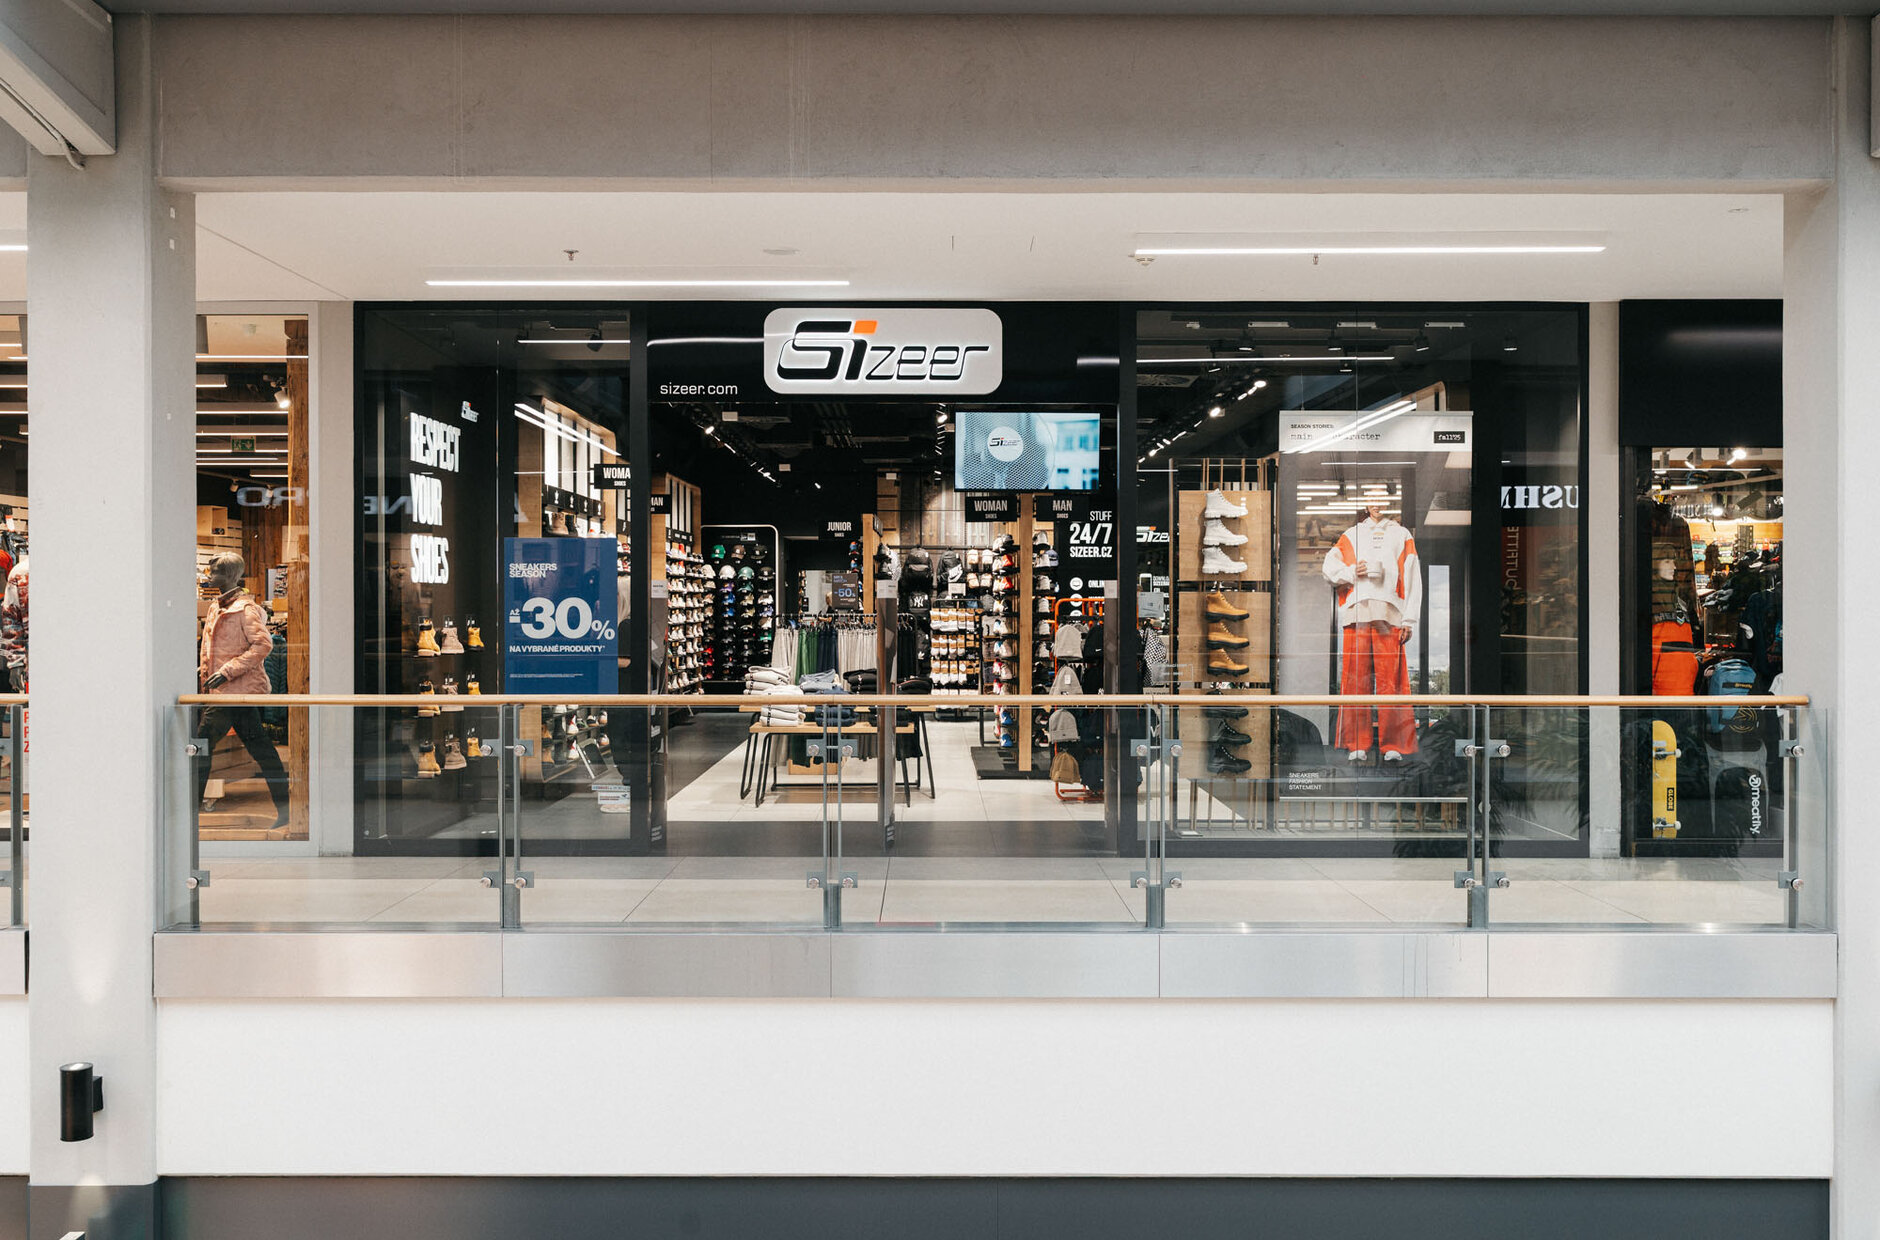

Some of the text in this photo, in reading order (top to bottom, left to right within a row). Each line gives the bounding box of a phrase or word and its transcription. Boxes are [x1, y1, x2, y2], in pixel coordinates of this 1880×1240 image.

[777, 320, 989, 380] Sizeer
[660, 382, 738, 394] sizeer.com
[410, 412, 461, 472] RESPECT
[603, 467, 631, 479] WOMA
[409, 473, 443, 526] YOUR
[974, 500, 1008, 511] WOMAN
[1053, 500, 1073, 511] MAN
[1090, 511, 1112, 521] STUFF
[827, 521, 852, 531] JUNIOR
[1069, 523, 1112, 544] 24/7
[1069, 546, 1112, 558] SIZEER.CZ
[410, 533, 449, 584] SHOES
[509, 563, 558, 571] SNEAKERS
[509, 570, 546, 578] SEASON
[509, 645, 520, 653] NA
[521, 644, 559, 653] VYBRANÉ
